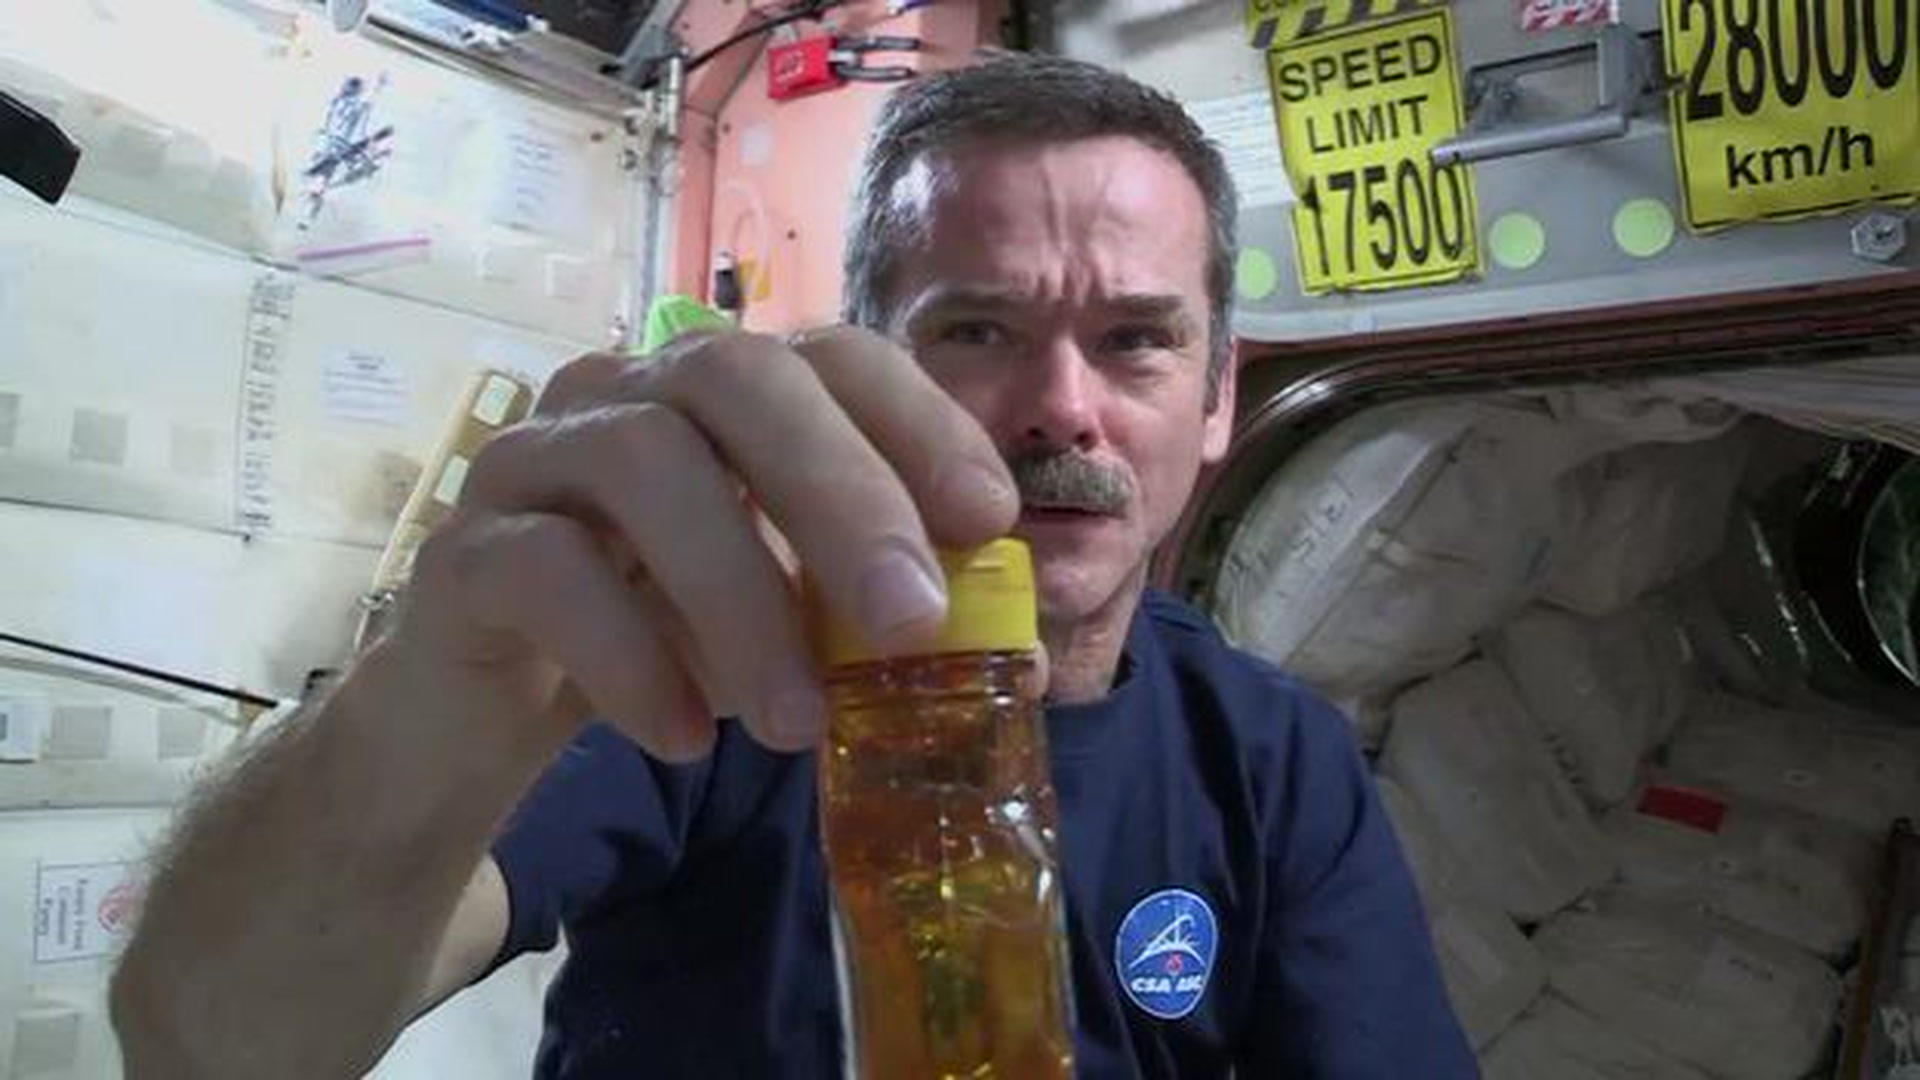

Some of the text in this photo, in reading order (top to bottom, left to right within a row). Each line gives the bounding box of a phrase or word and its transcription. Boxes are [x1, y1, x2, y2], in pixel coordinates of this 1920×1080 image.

[1279, 33, 1442, 102] SPEED
[1680, 0, 1907, 122] 28000
[1306, 94, 1428, 154] LIMIT
[1726, 126, 1874, 189] km/h
[1302, 157, 1465, 276] 17500
[1131, 977, 1171, 993] CSA
